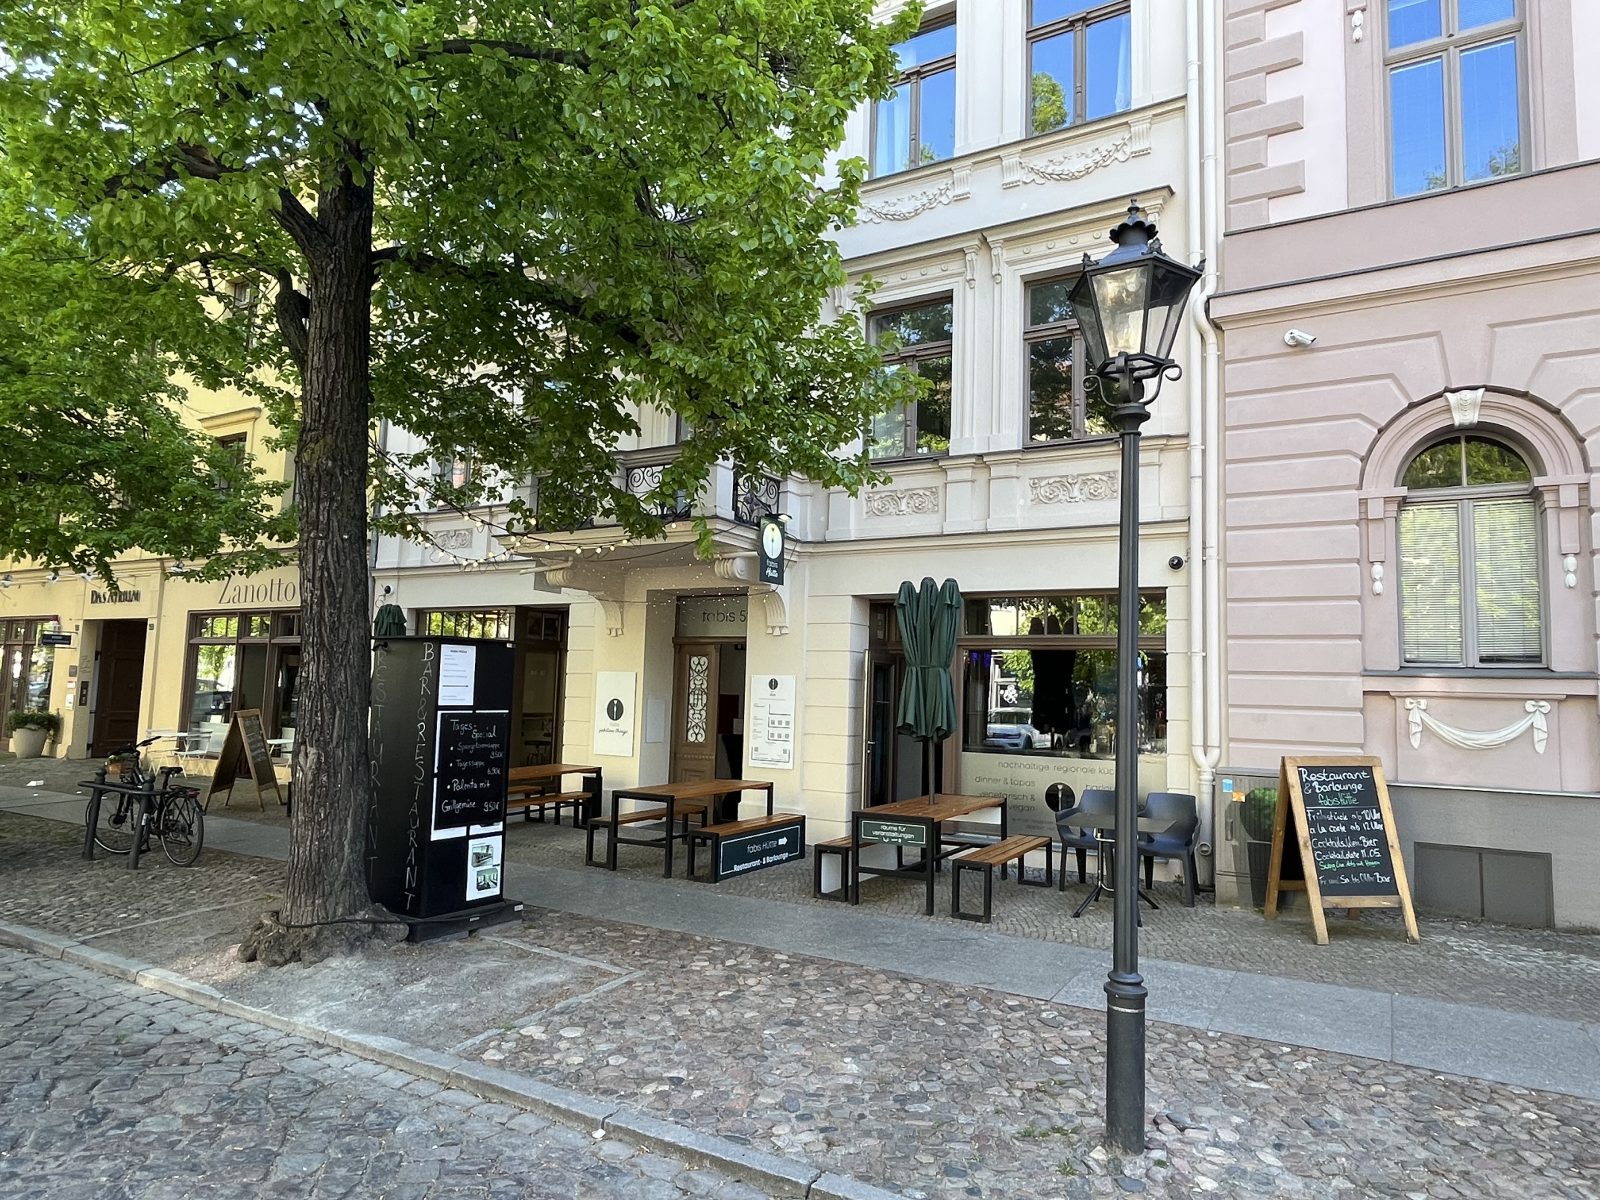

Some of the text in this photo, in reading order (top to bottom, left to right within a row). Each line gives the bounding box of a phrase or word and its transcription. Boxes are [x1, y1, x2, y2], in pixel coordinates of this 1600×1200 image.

[218, 575, 296, 604] Zanotto
[998, 760, 1050, 772] nachhaltige
[1053, 765, 1097, 774] regionale
[1298, 768, 1370, 782] Restaurant
[1010, 778, 1036, 787] tapas
[1304, 781, 1365, 794] & Barlounge
[766, 852, 789, 864] Barlounge
[1373, 872, 1392, 884] Bar
